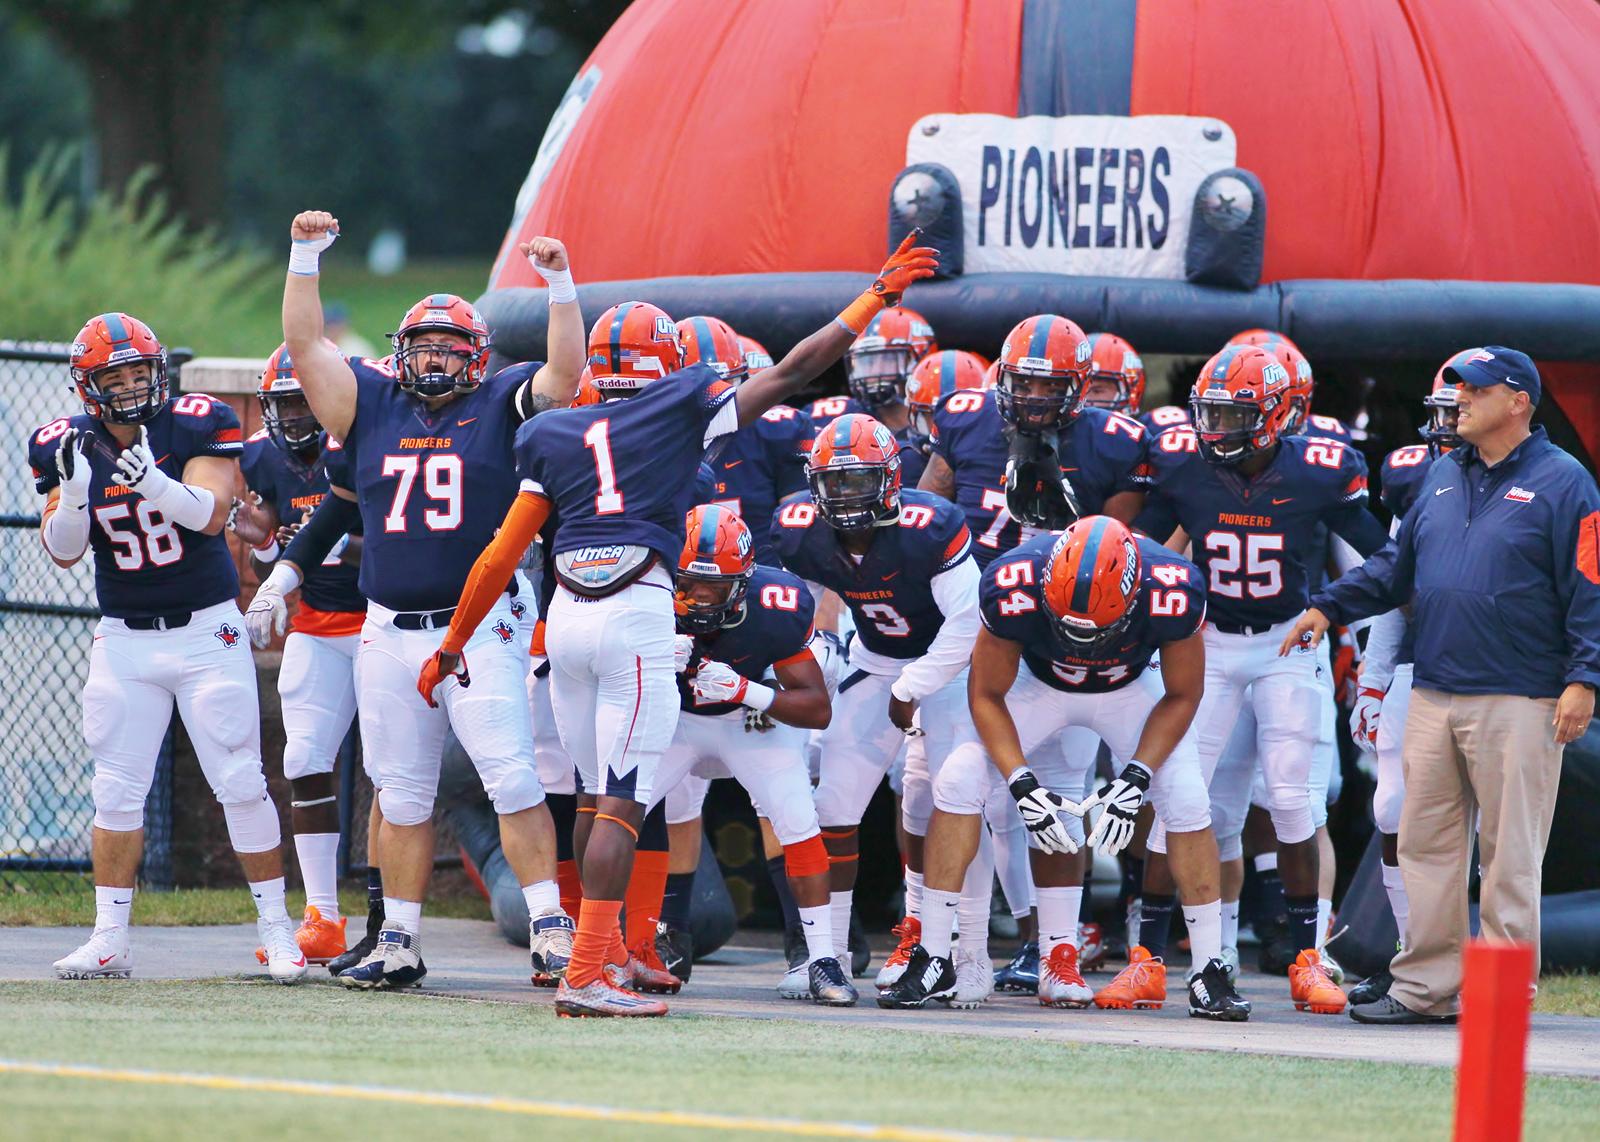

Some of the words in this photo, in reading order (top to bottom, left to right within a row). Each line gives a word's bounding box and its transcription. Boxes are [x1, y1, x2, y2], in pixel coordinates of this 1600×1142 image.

[978, 145, 1171, 250] PIONEERS
[399, 437, 452, 448] PIONEERS
[584, 418, 625, 516] 1
[381, 453, 464, 533] 79
[94, 499, 184, 570] 58
[1218, 513, 1272, 527] PIONEERS
[574, 545, 626, 562] UTICA
[1204, 530, 1284, 600] 25
[760, 583, 800, 612] 2
[844, 590, 894, 600] PIONEERS
[995, 559, 1039, 617] 54
[1150, 563, 1189, 617] 54
[920, 957, 944, 993] NIKE
[1191, 978, 1211, 1008] NIKE
